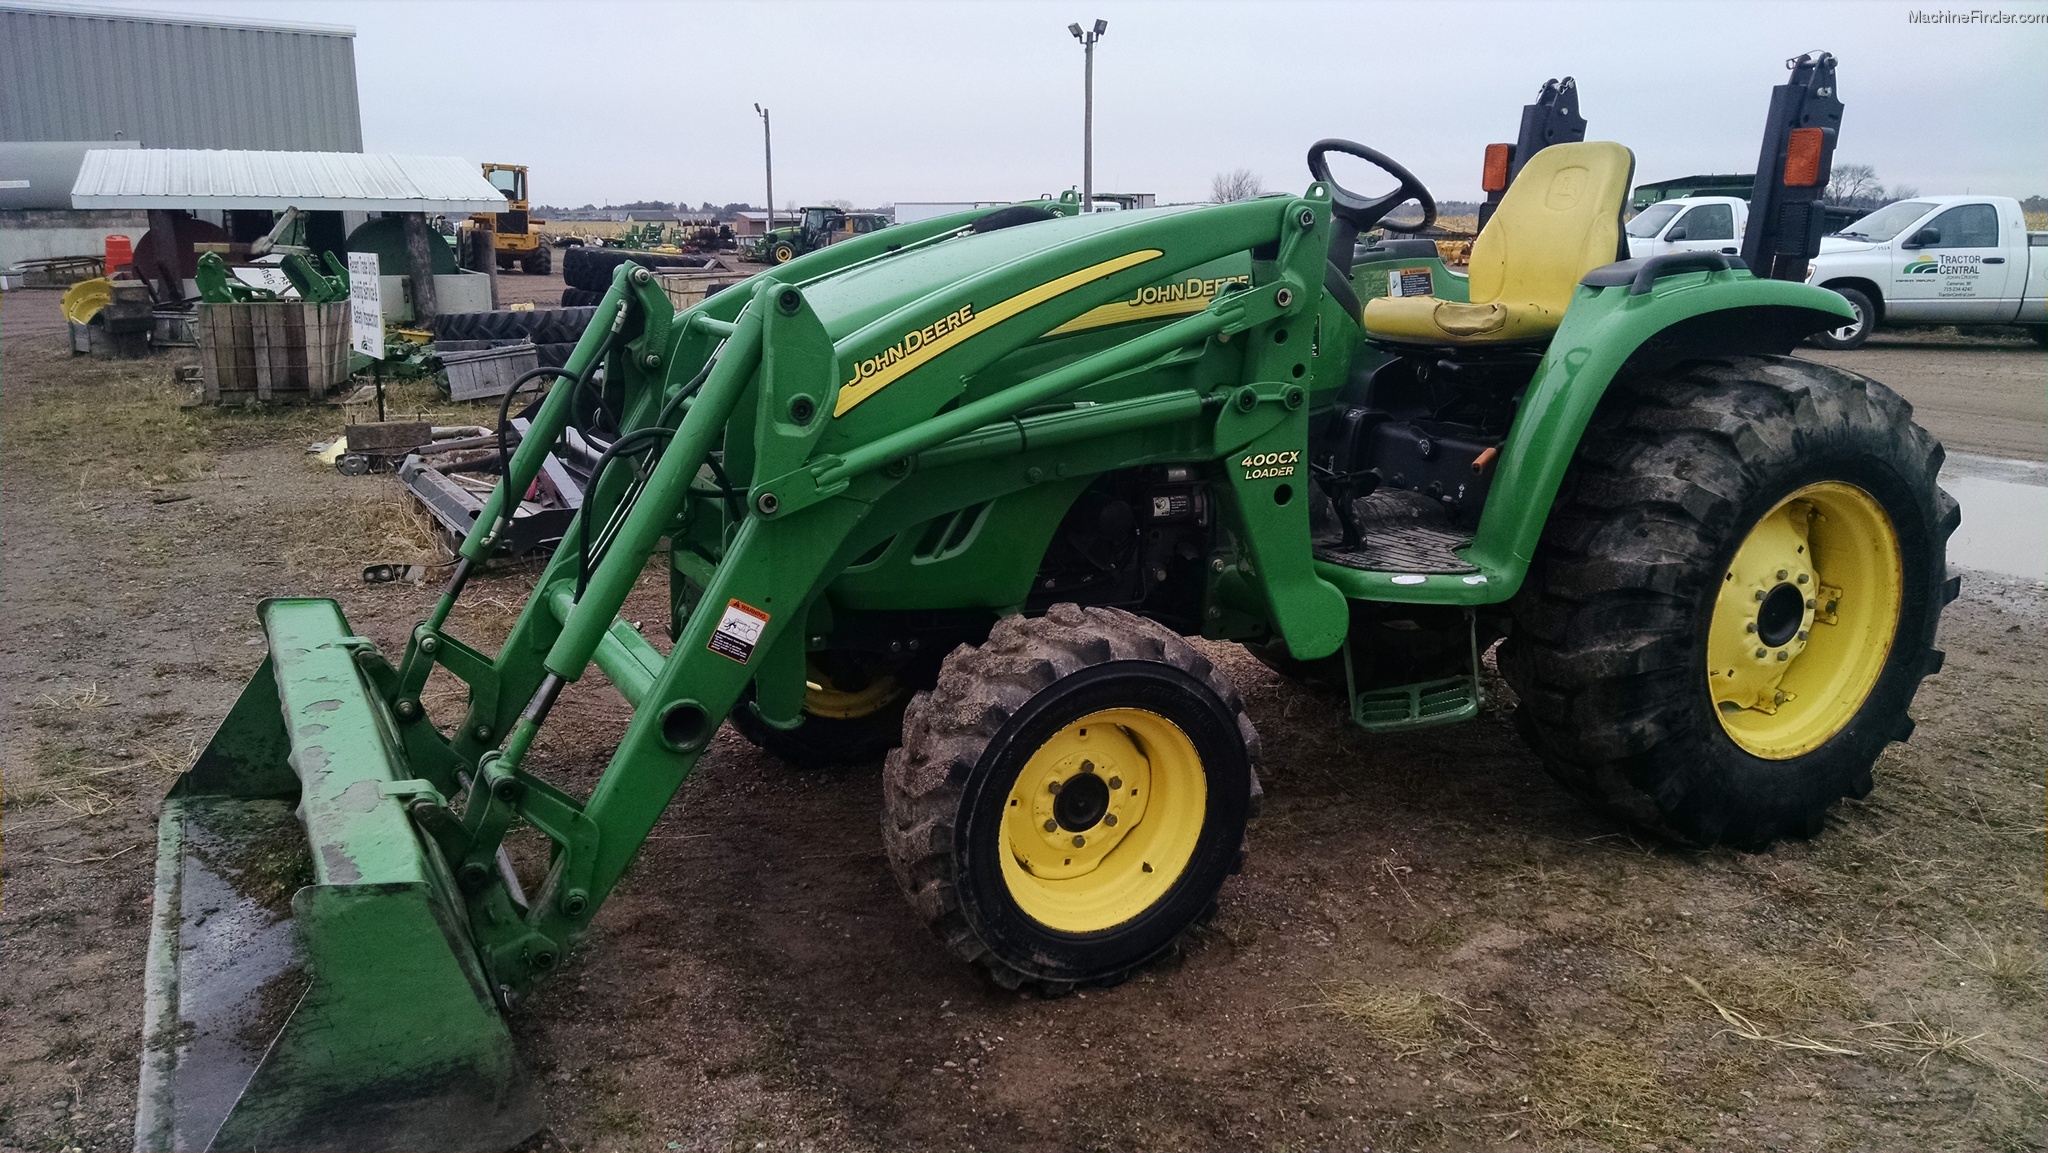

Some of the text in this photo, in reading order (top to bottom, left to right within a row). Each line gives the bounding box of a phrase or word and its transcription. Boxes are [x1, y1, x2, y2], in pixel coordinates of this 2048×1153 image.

[1939, 254, 1981, 264] TRACTOR
[1939, 265, 1980, 274] CENTRAL
[1129, 282, 1186, 306] JOHN
[848, 303, 974, 386] JOHN DEERE
[1241, 450, 1301, 468] 400CX
[1245, 466, 1294, 480] LOADER
[741, 604, 766, 620] WARNING
